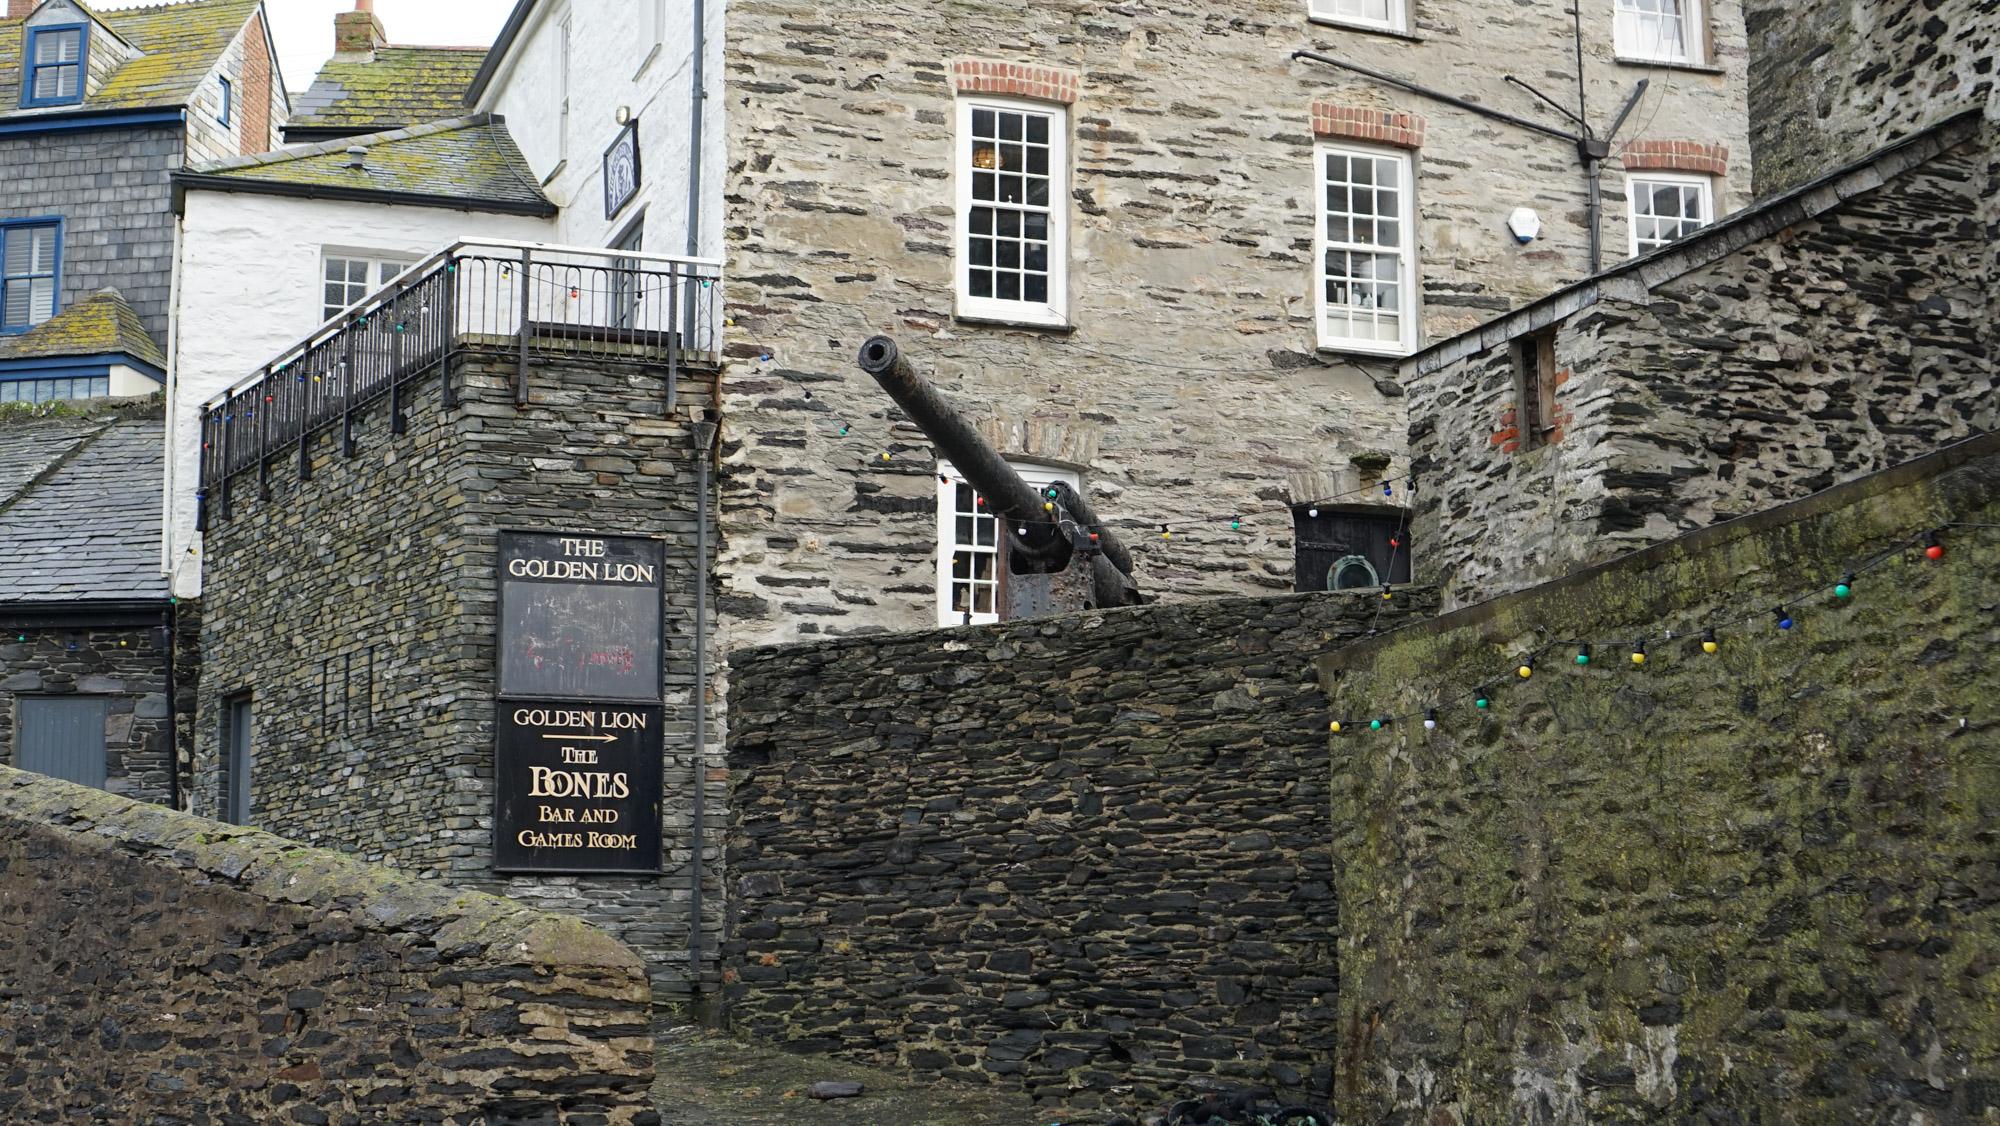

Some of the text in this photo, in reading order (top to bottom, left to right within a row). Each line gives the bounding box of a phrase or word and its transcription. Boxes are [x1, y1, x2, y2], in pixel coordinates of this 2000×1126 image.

[560, 538, 605, 557] THE
[509, 559, 654, 583] GOLDEN LION
[514, 709, 647, 729] GOLDEN LION
[561, 747, 598, 764] THE
[528, 766, 630, 799] BONES
[539, 805, 618, 824] BAR AND
[518, 830, 637, 850] GAMES ROOM
